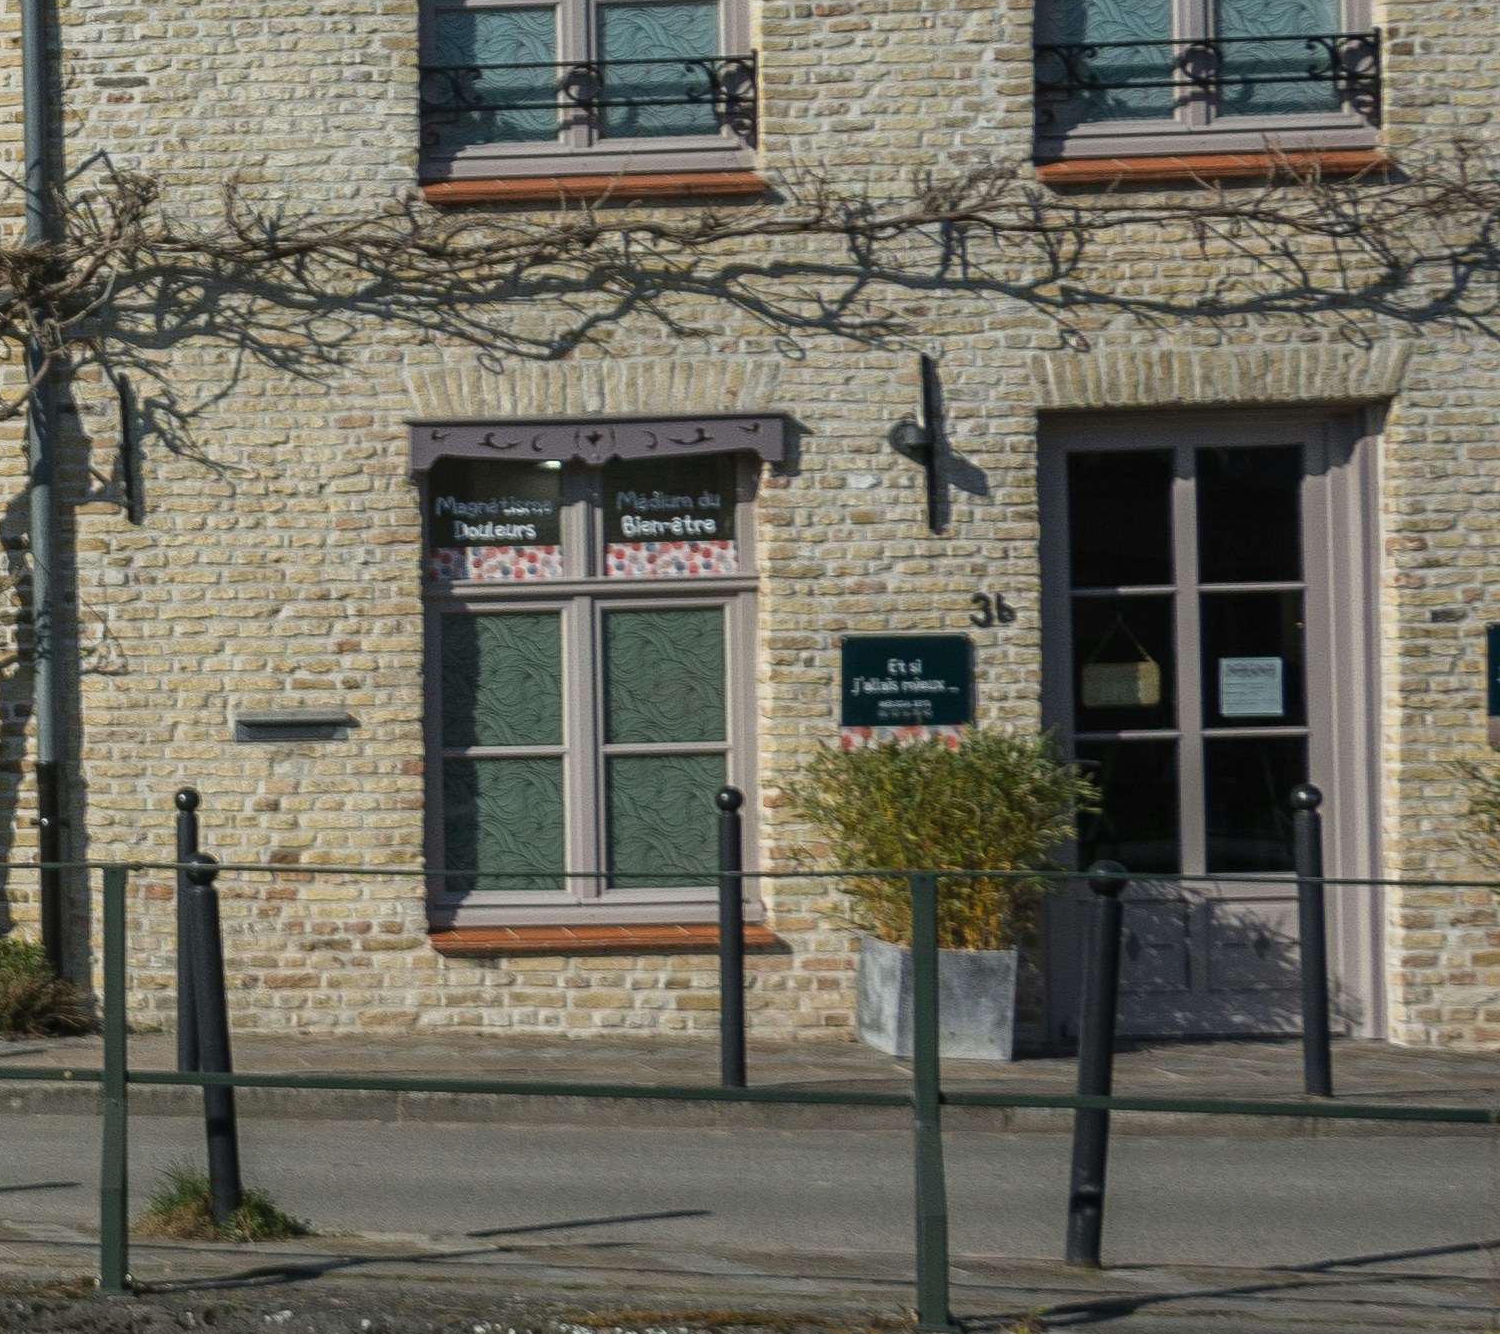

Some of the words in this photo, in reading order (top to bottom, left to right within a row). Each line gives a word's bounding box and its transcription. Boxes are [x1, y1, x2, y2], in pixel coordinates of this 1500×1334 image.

[615, 491, 695, 512] Médium
[698, 490, 722, 510] du
[453, 521, 537, 541] Douleurs
[620, 514, 718, 538] Bien-être
[887, 658, 907, 675] Et
[908, 658, 923, 675] si
[901, 676, 947, 693] mieux
